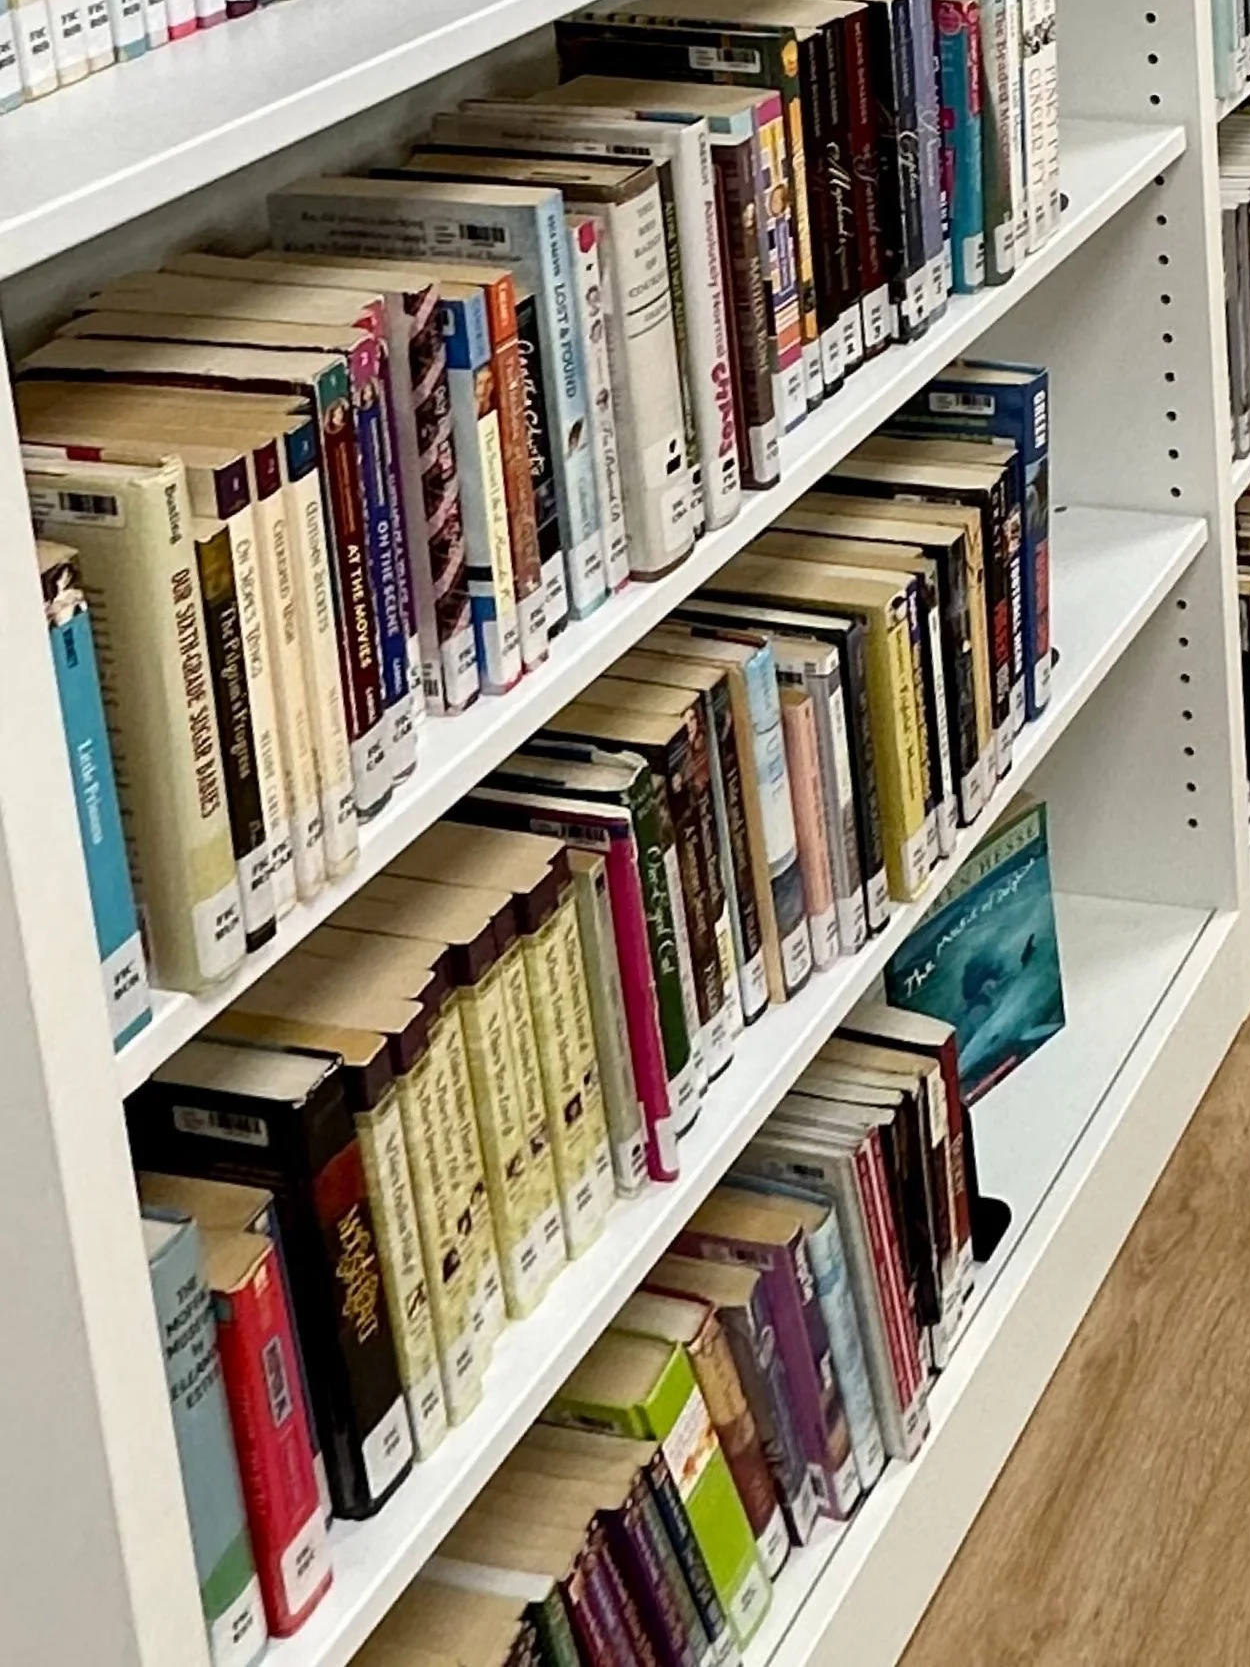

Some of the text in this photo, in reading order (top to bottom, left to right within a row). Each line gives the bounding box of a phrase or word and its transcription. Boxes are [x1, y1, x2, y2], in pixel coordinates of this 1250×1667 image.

[704, 200, 721, 287] Absolutely
[553, 283, 572, 326] LOST
[560, 341, 577, 398] FOUND
[1033, 389, 1046, 449] GREEN
[346, 544, 371, 670] AT THE MOVIES
[377, 519, 398, 637] ON THE SCENE
[1008, 557, 1023, 627] FOOTBALL
[218, 606, 238, 638] The
[170, 569, 221, 818] OUR SIXTH-GRADE SUGAR BABIES
[903, 960, 936, 999] The
